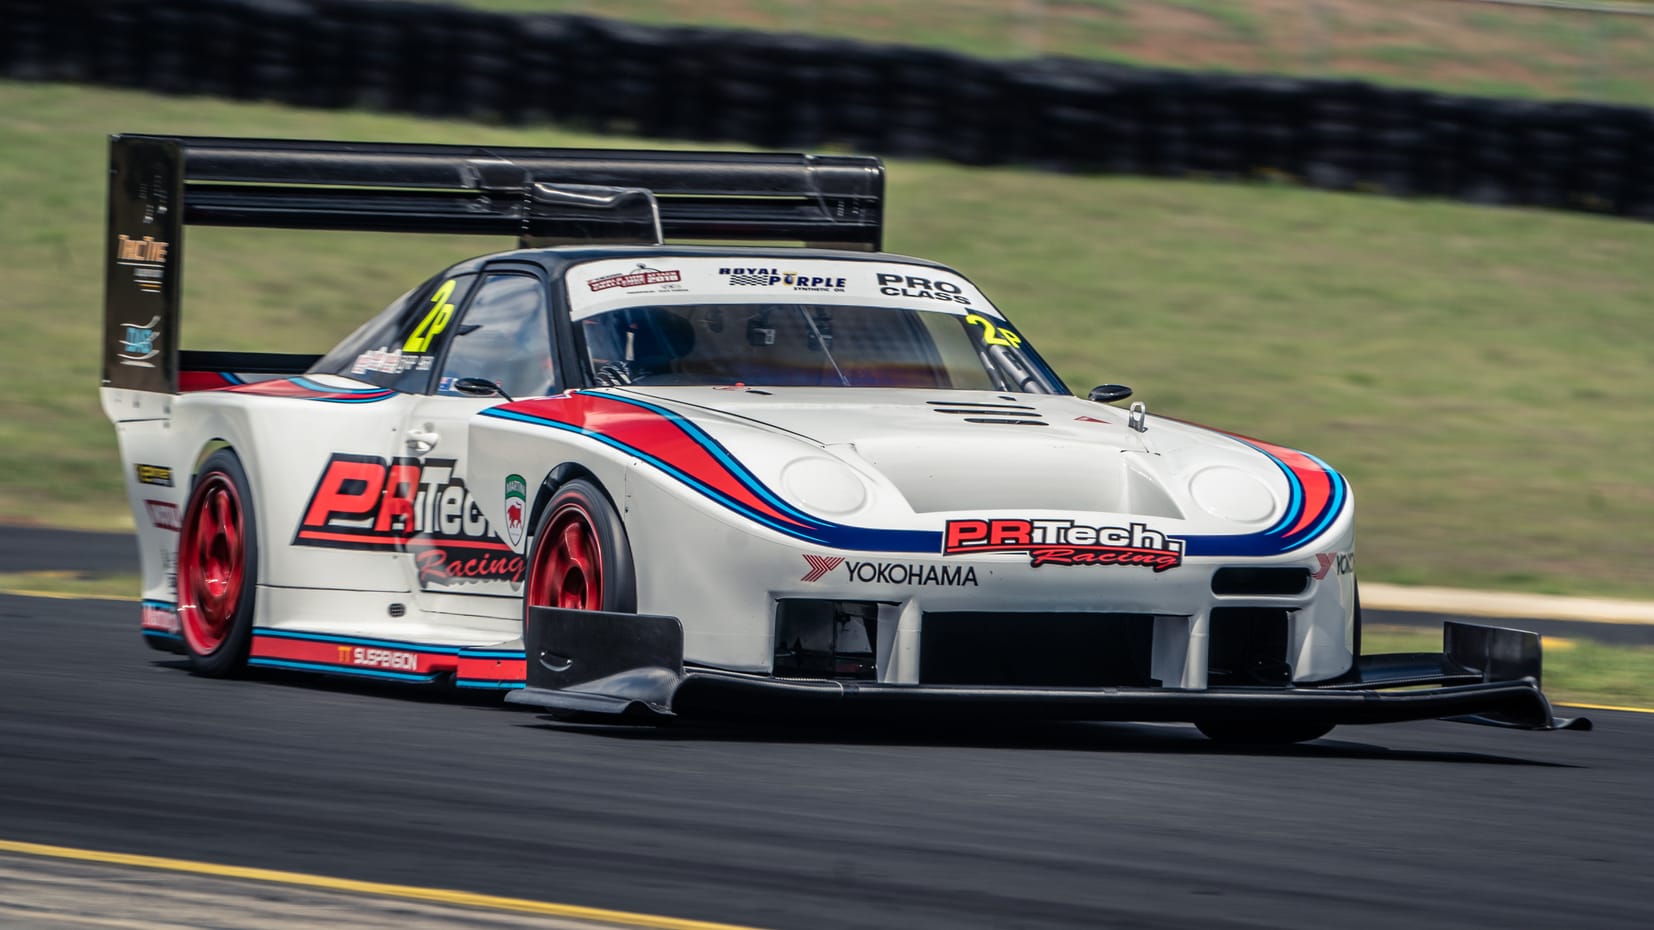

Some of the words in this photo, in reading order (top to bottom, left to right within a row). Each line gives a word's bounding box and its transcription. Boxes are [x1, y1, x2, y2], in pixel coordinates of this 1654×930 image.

[768, 272, 846, 288] PURPLE
[876, 273, 962, 295] PRO
[880, 286, 972, 305] CLASS
[402, 279, 457, 352] 2P
[965, 313, 1022, 349] 2P
[303, 459, 498, 538] PRTec
[946, 519, 1164, 547] PRTech
[417, 549, 526, 583] Racing
[845, 560, 979, 586] YOKOHAMA
[1034, 548, 1178, 571] Racing
